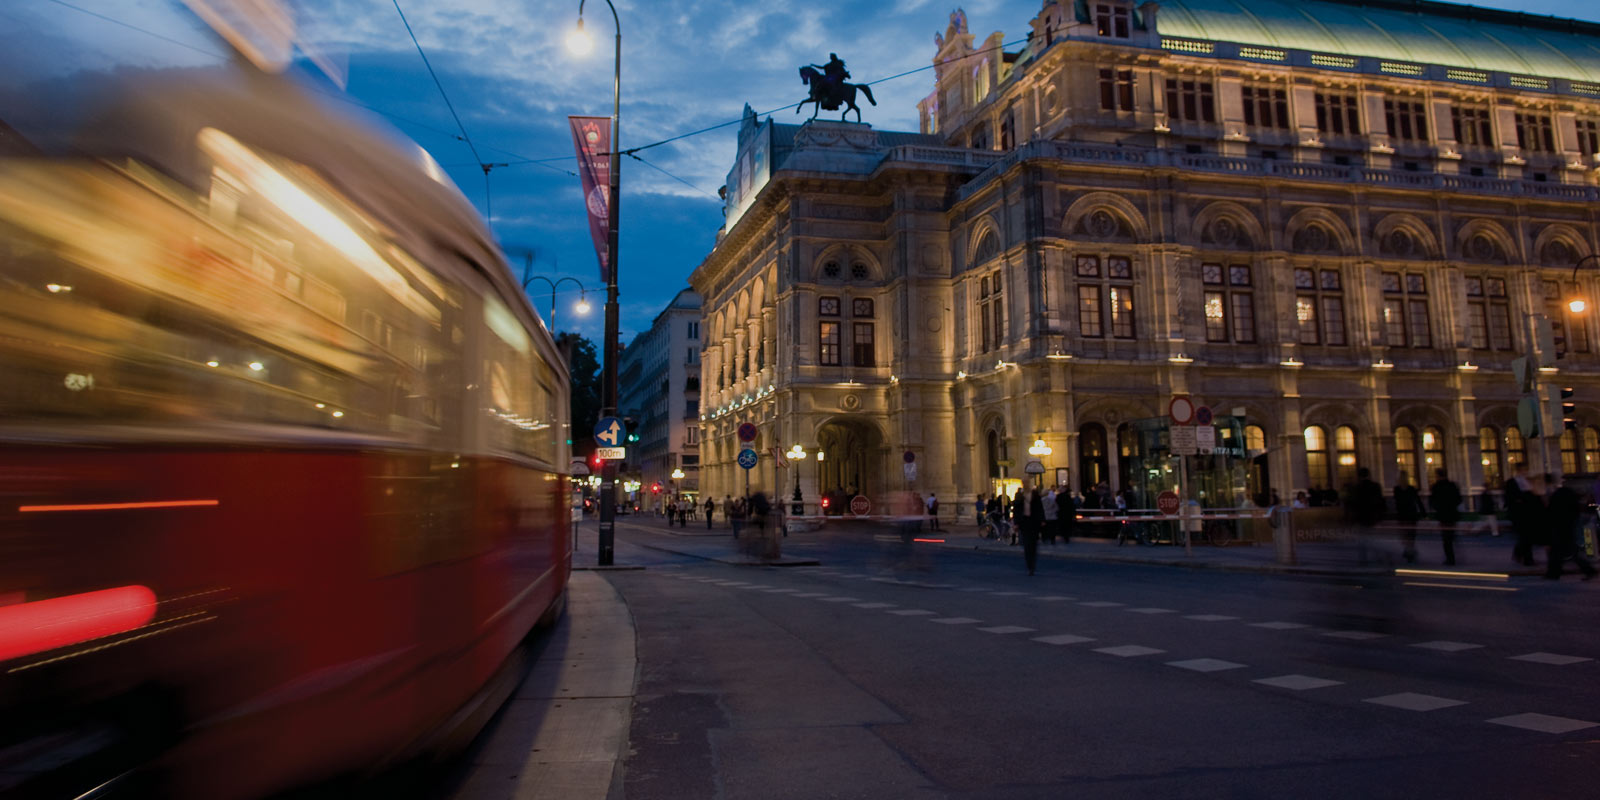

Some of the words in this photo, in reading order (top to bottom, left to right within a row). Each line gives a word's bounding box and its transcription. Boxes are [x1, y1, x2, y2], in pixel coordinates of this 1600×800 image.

[599, 449, 622, 458] 100m
[852, 501, 868, 510] STOP
[1159, 497, 1178, 508] STOP
